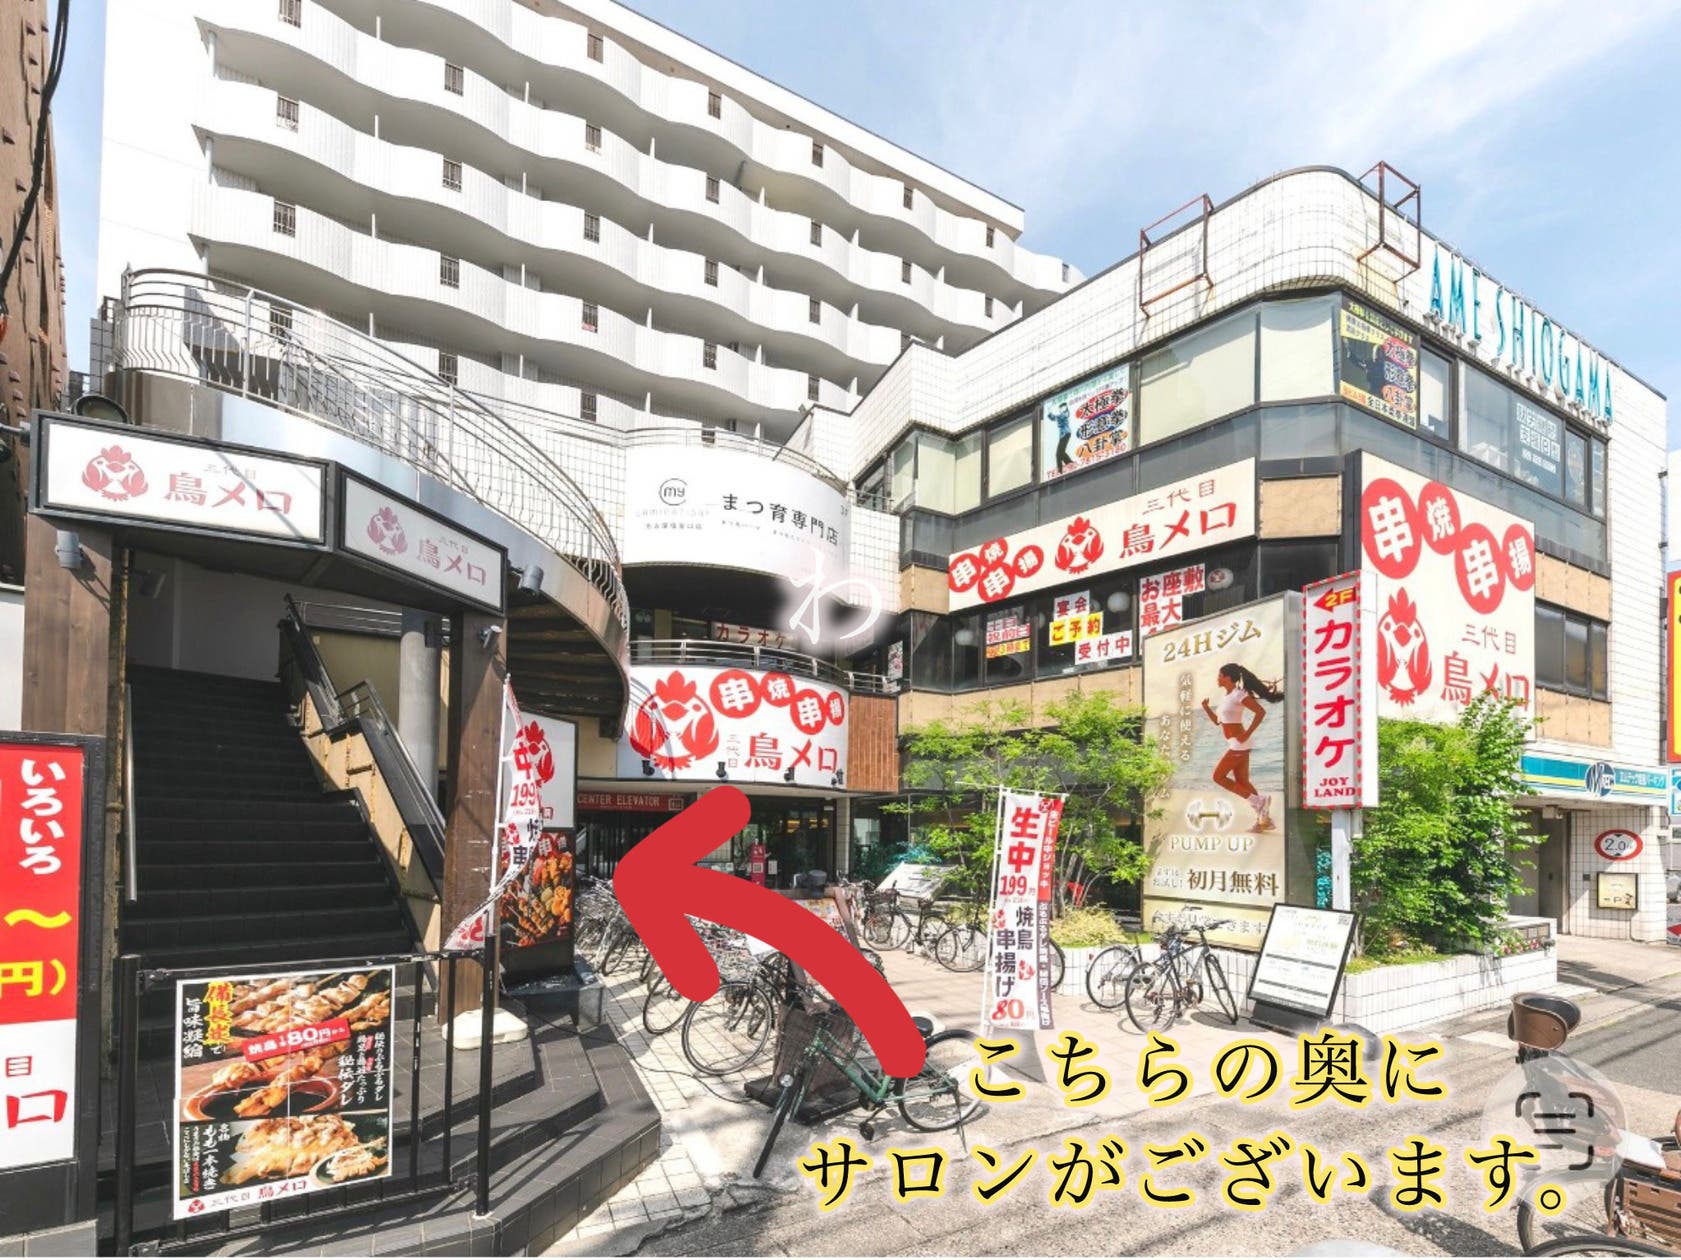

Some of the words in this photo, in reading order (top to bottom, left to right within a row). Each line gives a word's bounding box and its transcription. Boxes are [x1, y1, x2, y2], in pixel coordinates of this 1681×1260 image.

[1430, 241, 1481, 342] AME
[1497, 284, 1613, 424] SHIOGAMA
[165, 470, 293, 515] 鳥メロ
[1142, 479, 1216, 515] 三代目
[722, 494, 839, 546] まつ育専門店
[1119, 502, 1237, 559] 鳥メロ
[416, 538, 487, 587] 鳥メロ
[1142, 568, 1205, 602] お座敷
[1325, 590, 1351, 607] 2F
[1057, 596, 1088, 616] 宴会
[1141, 598, 1181, 627] 最大
[716, 623, 787, 649] カラオケ
[1052, 619, 1102, 642] ご予約
[1078, 635, 1131, 660] 受付中
[1163, 620, 1262, 663] 24Hジム
[1462, 624, 1516, 655] 三代目
[1314, 619, 1355, 768] カラオケ
[1441, 651, 1531, 711] 鳥メロ
[744, 732, 838, 774] 鳥メロ
[1314, 787, 1356, 798] LAND
[1320, 777, 1349, 786] JOY
[19, 758, 66, 876] いろいろ
[616, 795, 660, 807] ELEVATOR
[1007, 805, 1040, 874] 生中
[1170, 835, 1222, 851] PUMP
[1228, 836, 1254, 852] UP
[1186, 868, 1280, 897] 初月無料
[1016, 906, 1034, 951] 焼鳥
[994, 930, 1016, 997] 串揚げ
[257, 1180, 307, 1199] 鳥メロ
